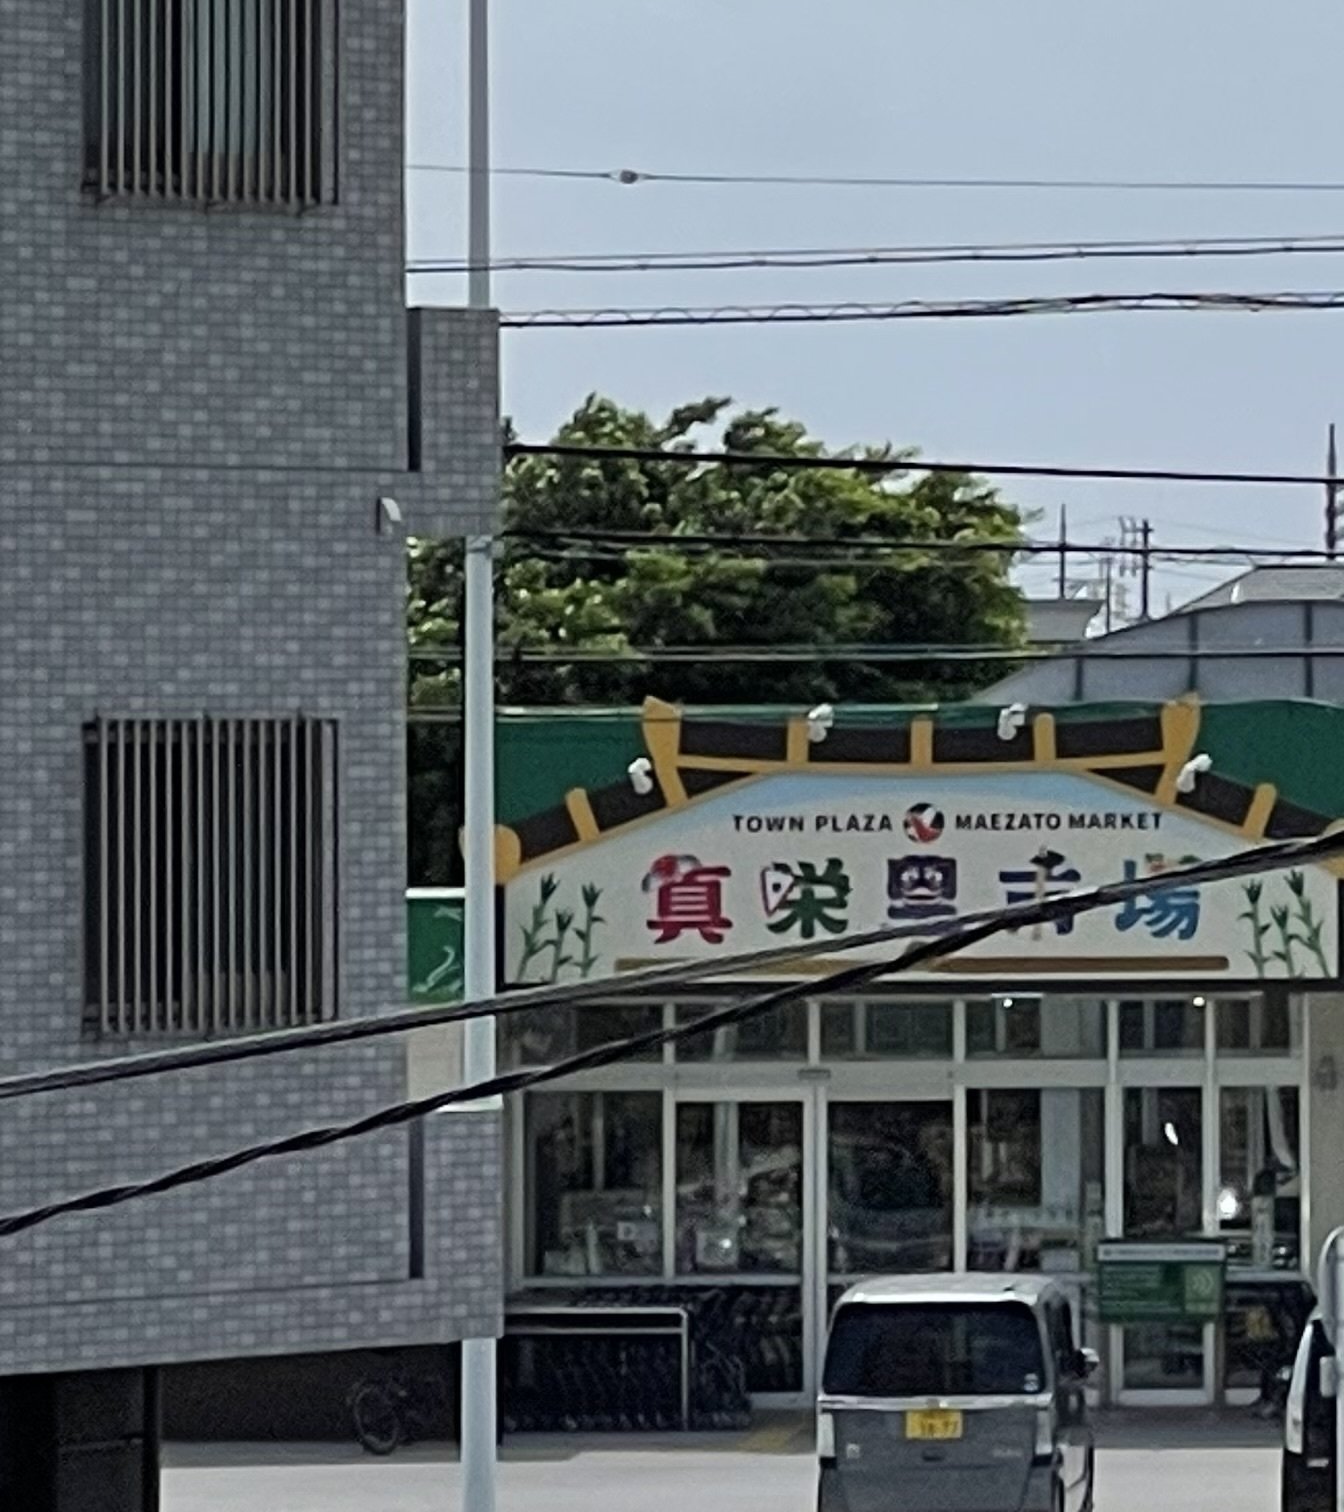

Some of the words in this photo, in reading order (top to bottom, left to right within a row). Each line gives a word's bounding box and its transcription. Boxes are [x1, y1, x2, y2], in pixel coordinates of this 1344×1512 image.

[732, 814, 804, 833] TOWN
[815, 813, 893, 832] PLAZA
[955, 813, 1061, 831] MAEZATO
[1068, 812, 1163, 830] MARKET
